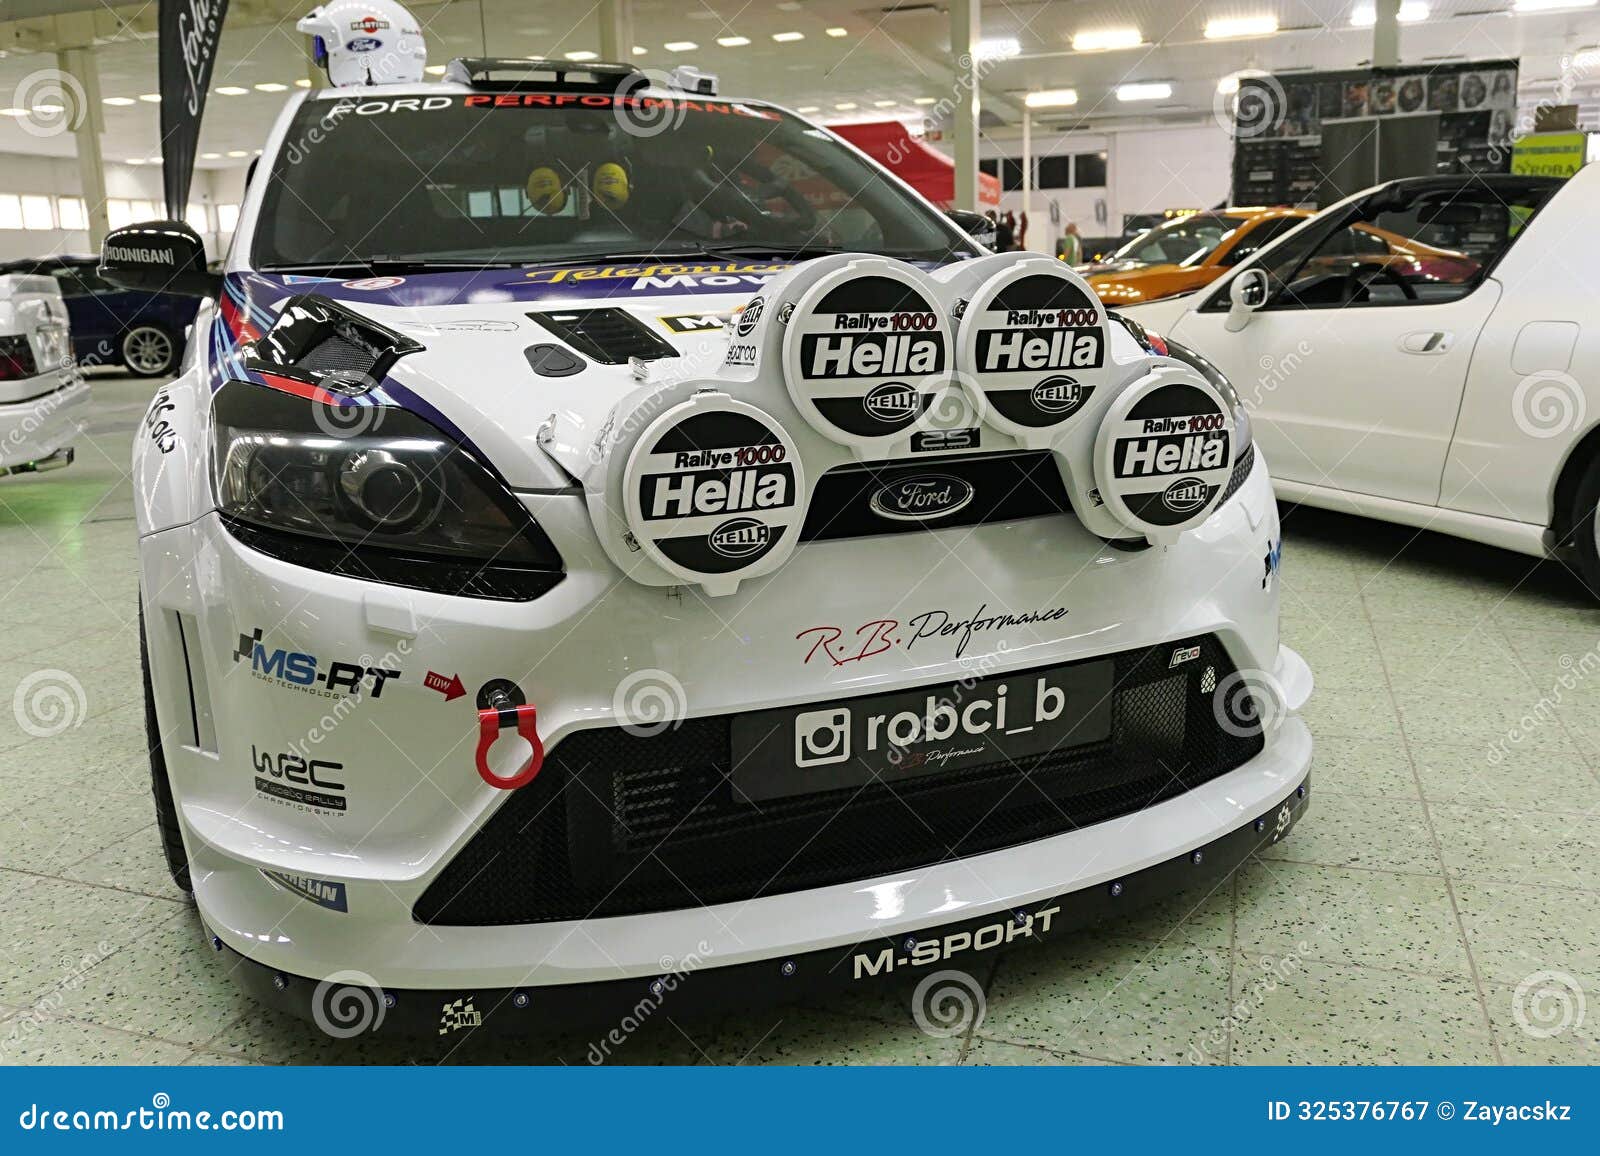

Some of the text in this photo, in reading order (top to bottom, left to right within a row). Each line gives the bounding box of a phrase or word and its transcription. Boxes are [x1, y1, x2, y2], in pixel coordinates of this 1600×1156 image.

[327, 96, 453, 119] FORD
[835, 312, 938, 331] Rallye 1000
[1006, 309, 1099, 328] Rallye 1000
[811, 334, 938, 376] Hella
[984, 330, 1098, 370] Hella
[868, 391, 920, 409] HELLA
[1034, 383, 1081, 400] HELLA
[1142, 413, 1225, 434] Rallye 1000
[674, 444, 786, 469] Rallye 1000
[1121, 435, 1224, 476] Hella
[651, 469, 787, 517] Hella
[897, 481, 952, 509] Ford
[1165, 483, 1207, 500] HELLA
[713, 524, 769, 545] HELLA
[906, 604, 1068, 659] Performance
[251, 642, 402, 699] MS-RT
[428, 675, 452, 691] TOW
[276, 679, 348, 701] TECHNOLOGY
[866, 678, 1065, 751] robci_b
[251, 744, 345, 790] WRC
[257, 791, 345, 818] CHAMPIONSHIP
[853, 906, 1061, 980] M-SPORT
